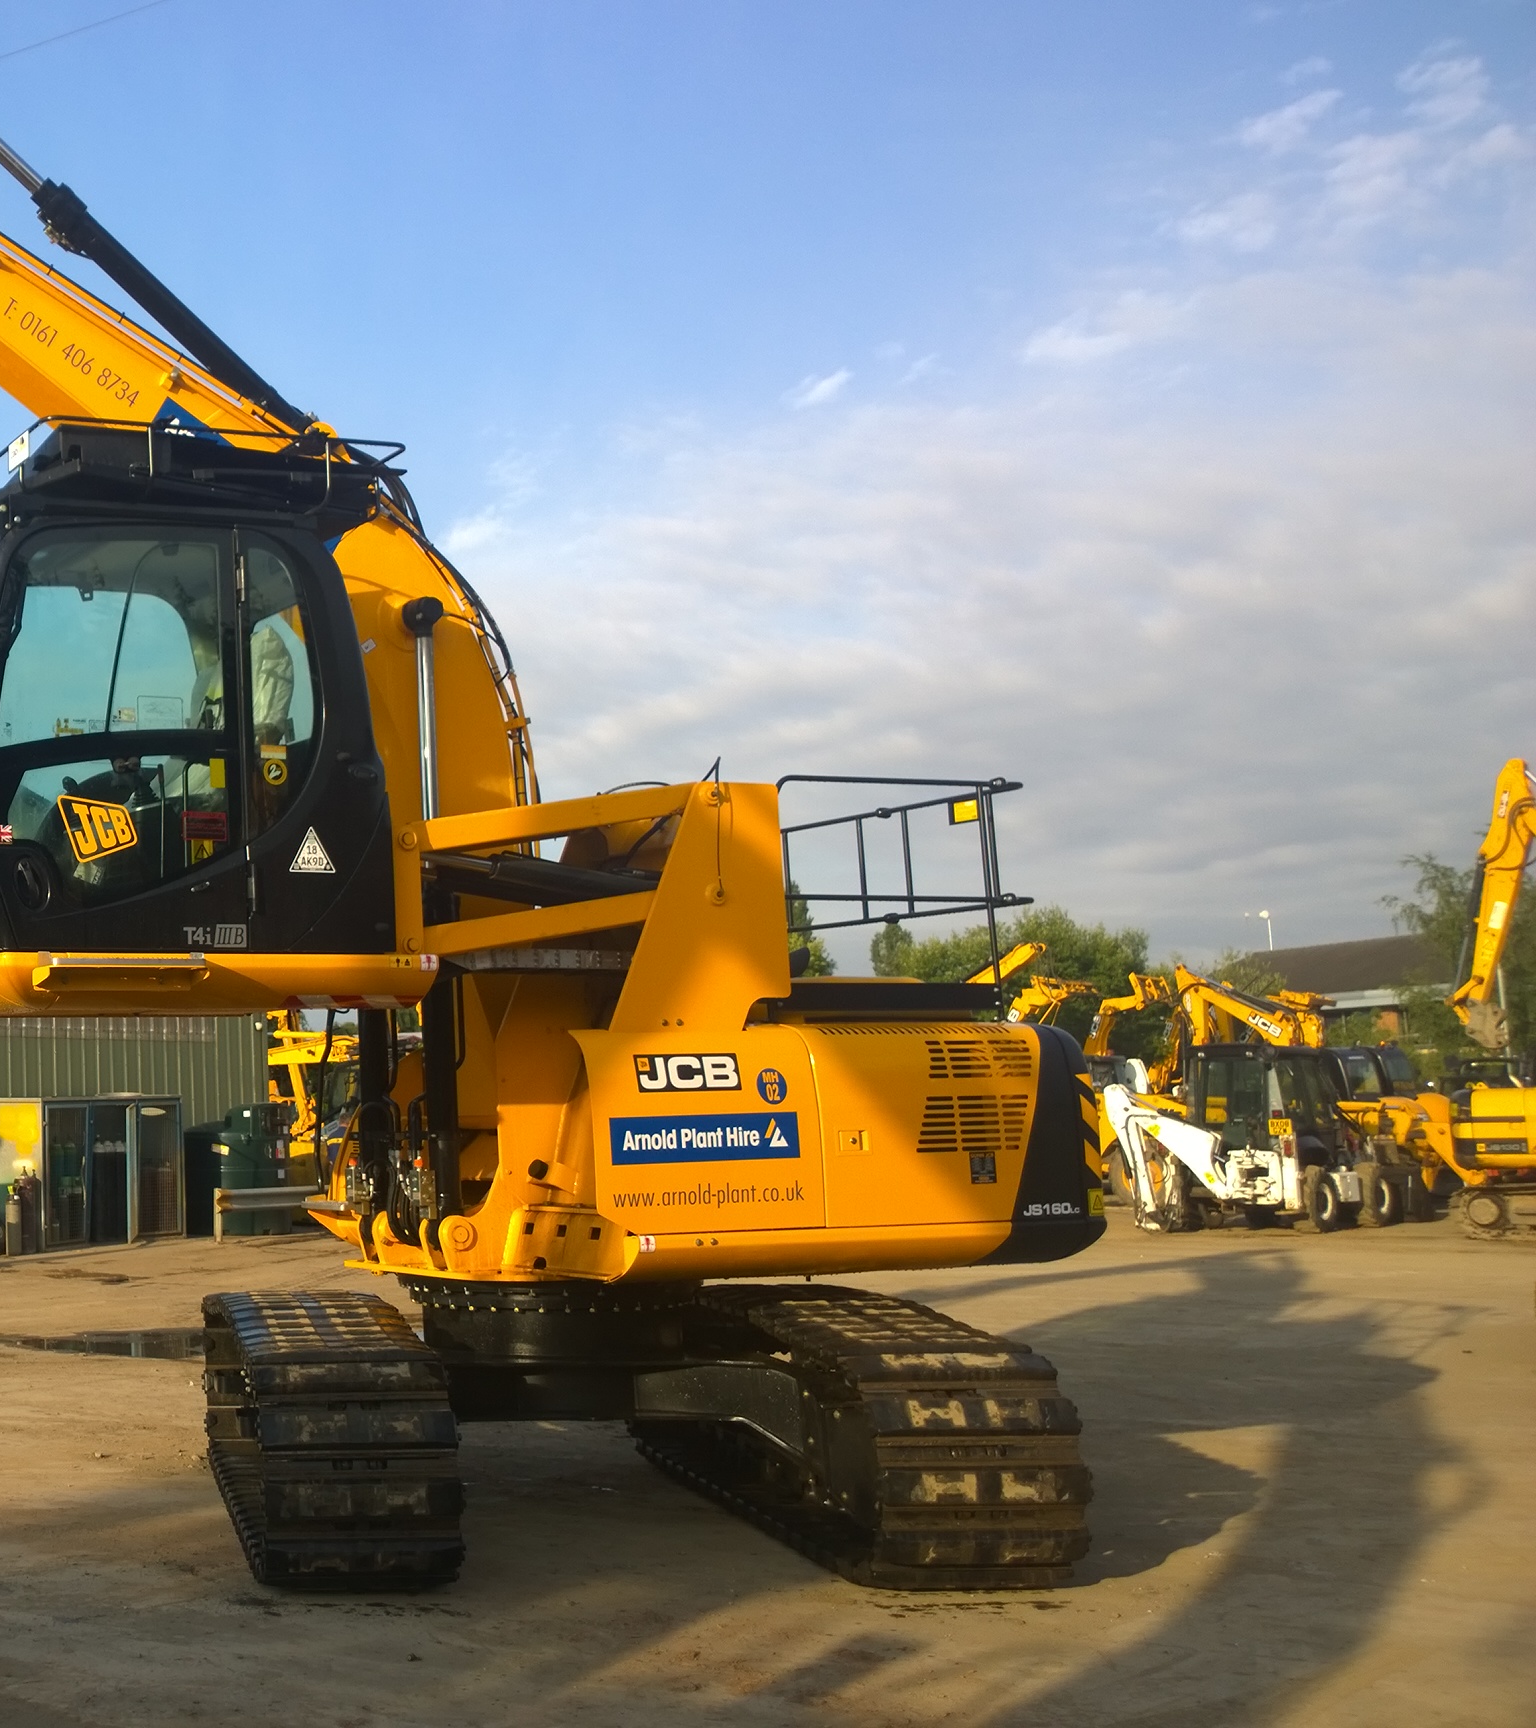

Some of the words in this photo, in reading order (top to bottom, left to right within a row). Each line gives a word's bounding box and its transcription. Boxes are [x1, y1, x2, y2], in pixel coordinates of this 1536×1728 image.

[3, 297, 17, 320] T:
[20, 311, 58, 347] 0161
[62, 343, 95, 375] 406
[97, 367, 140, 408] 8734
[71, 802, 132, 856] JCB
[306, 845, 317, 854] 18
[183, 926, 212, 945] T4i
[1248, 1014, 1282, 1038] JCB
[639, 1056, 739, 1090] JCB
[762, 1071, 779, 1083] MH
[766, 1083, 781, 1101] 02
[622, 1128, 677, 1151] Arnold
[680, 1127, 724, 1149] Plant
[726, 1126, 760, 1148] Hire
[613, 1180, 805, 1208] www.arnold-plant.co.uk
